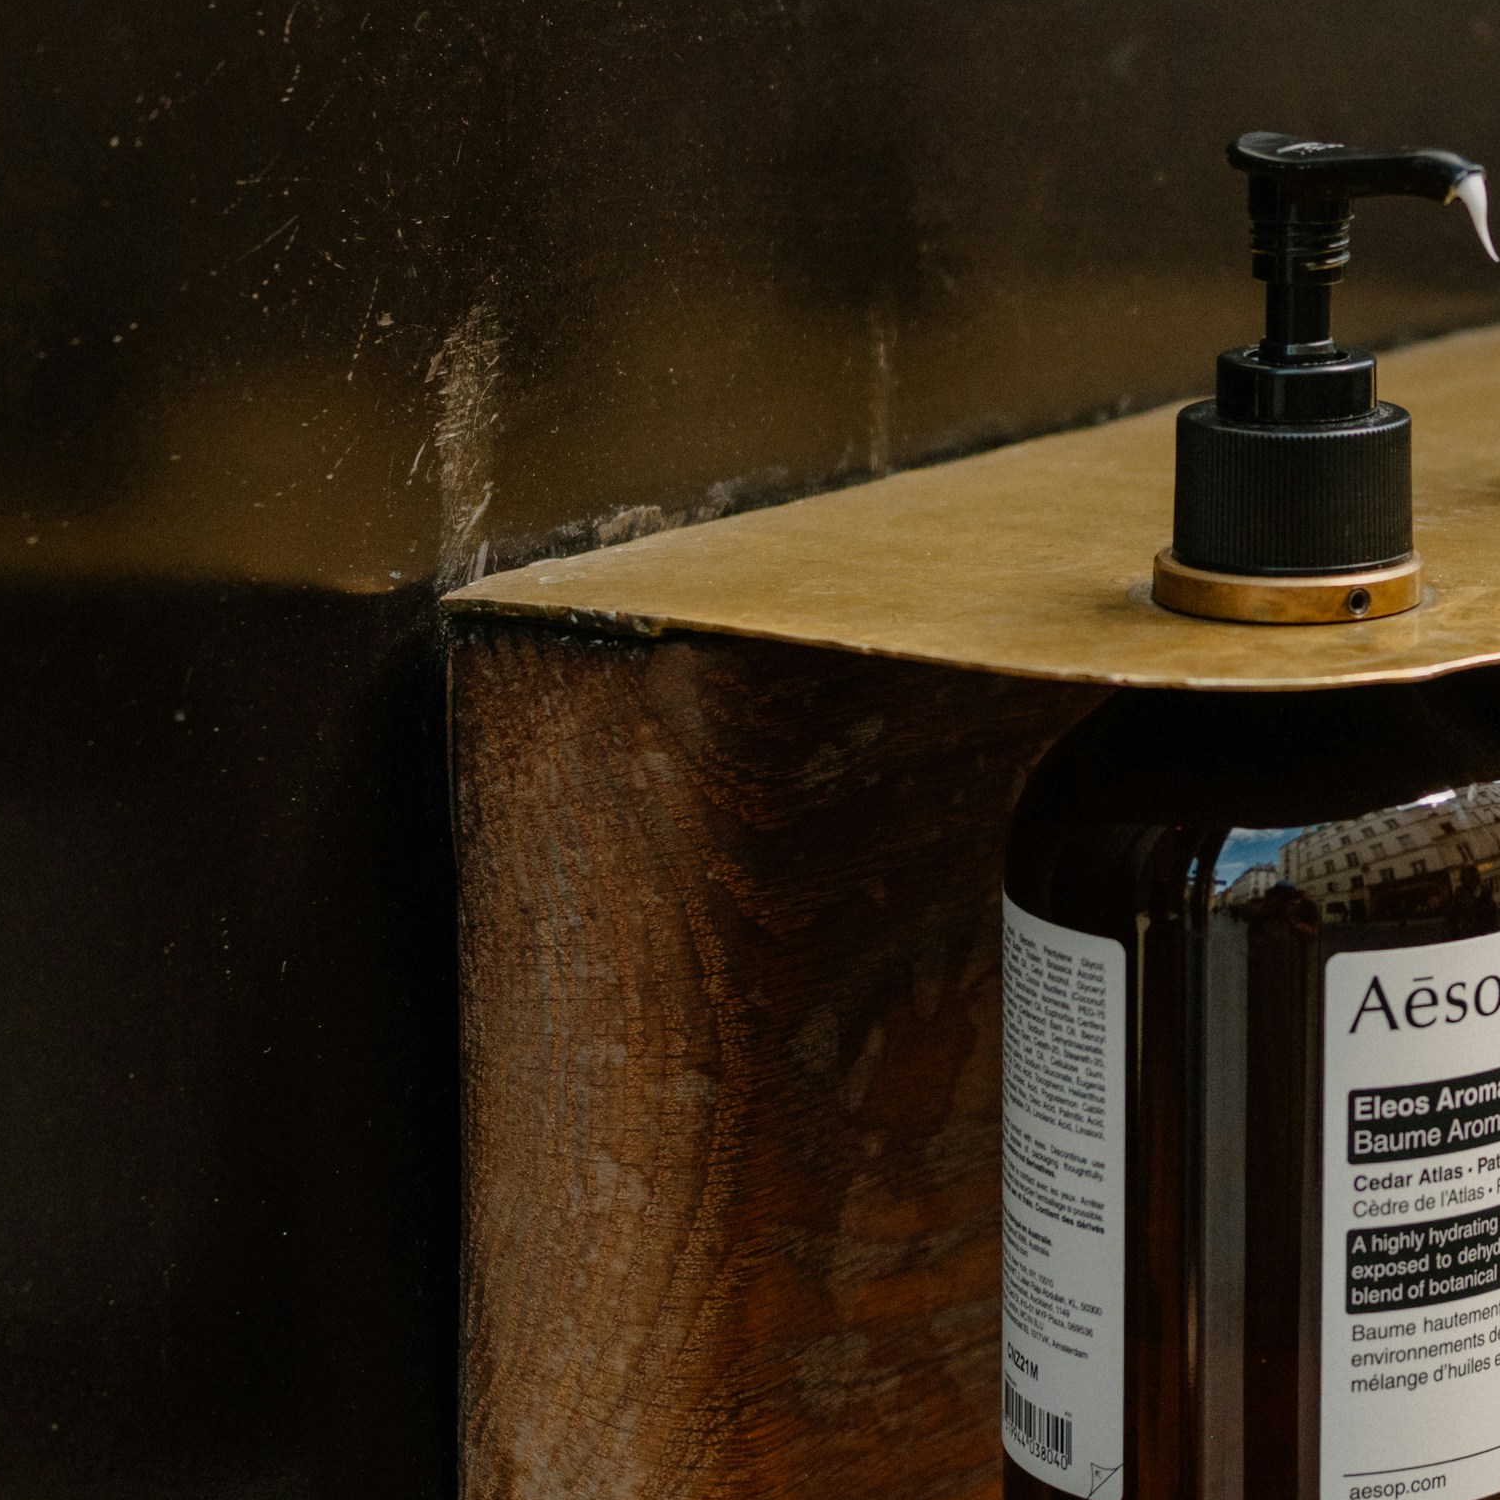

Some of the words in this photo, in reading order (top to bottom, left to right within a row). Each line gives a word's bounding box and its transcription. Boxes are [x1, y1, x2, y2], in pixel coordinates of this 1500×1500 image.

[1353, 1094, 1431, 1122] Eleos
[1353, 1126, 1442, 1155] Baume
[1353, 1172, 1414, 1193] Cedar
[1418, 1164, 1464, 1186] Atlas
[1353, 1199, 1410, 1218] Cèdre
[1414, 1197, 1437, 1212] de
[1440, 1184, 1485, 1208] l'Atlas
[1352, 1235, 1367, 1254] A
[1371, 1229, 1426, 1256] highly
[1429, 1216, 1499, 1248] hydrating
[1351, 1252, 1430, 1282] exposed
[1436, 1252, 1453, 1270] to
[1351, 1284, 1404, 1306] blend
[1407, 1283, 1426, 1300] of
[1429, 1267, 1498, 1299] botanical
[1352, 1322, 1417, 1342] Baume
[1351, 1332, 1485, 1368] environnements
[1351, 1371, 1429, 1393] mélange
[1433, 1355, 1491, 1382] d'huiles
